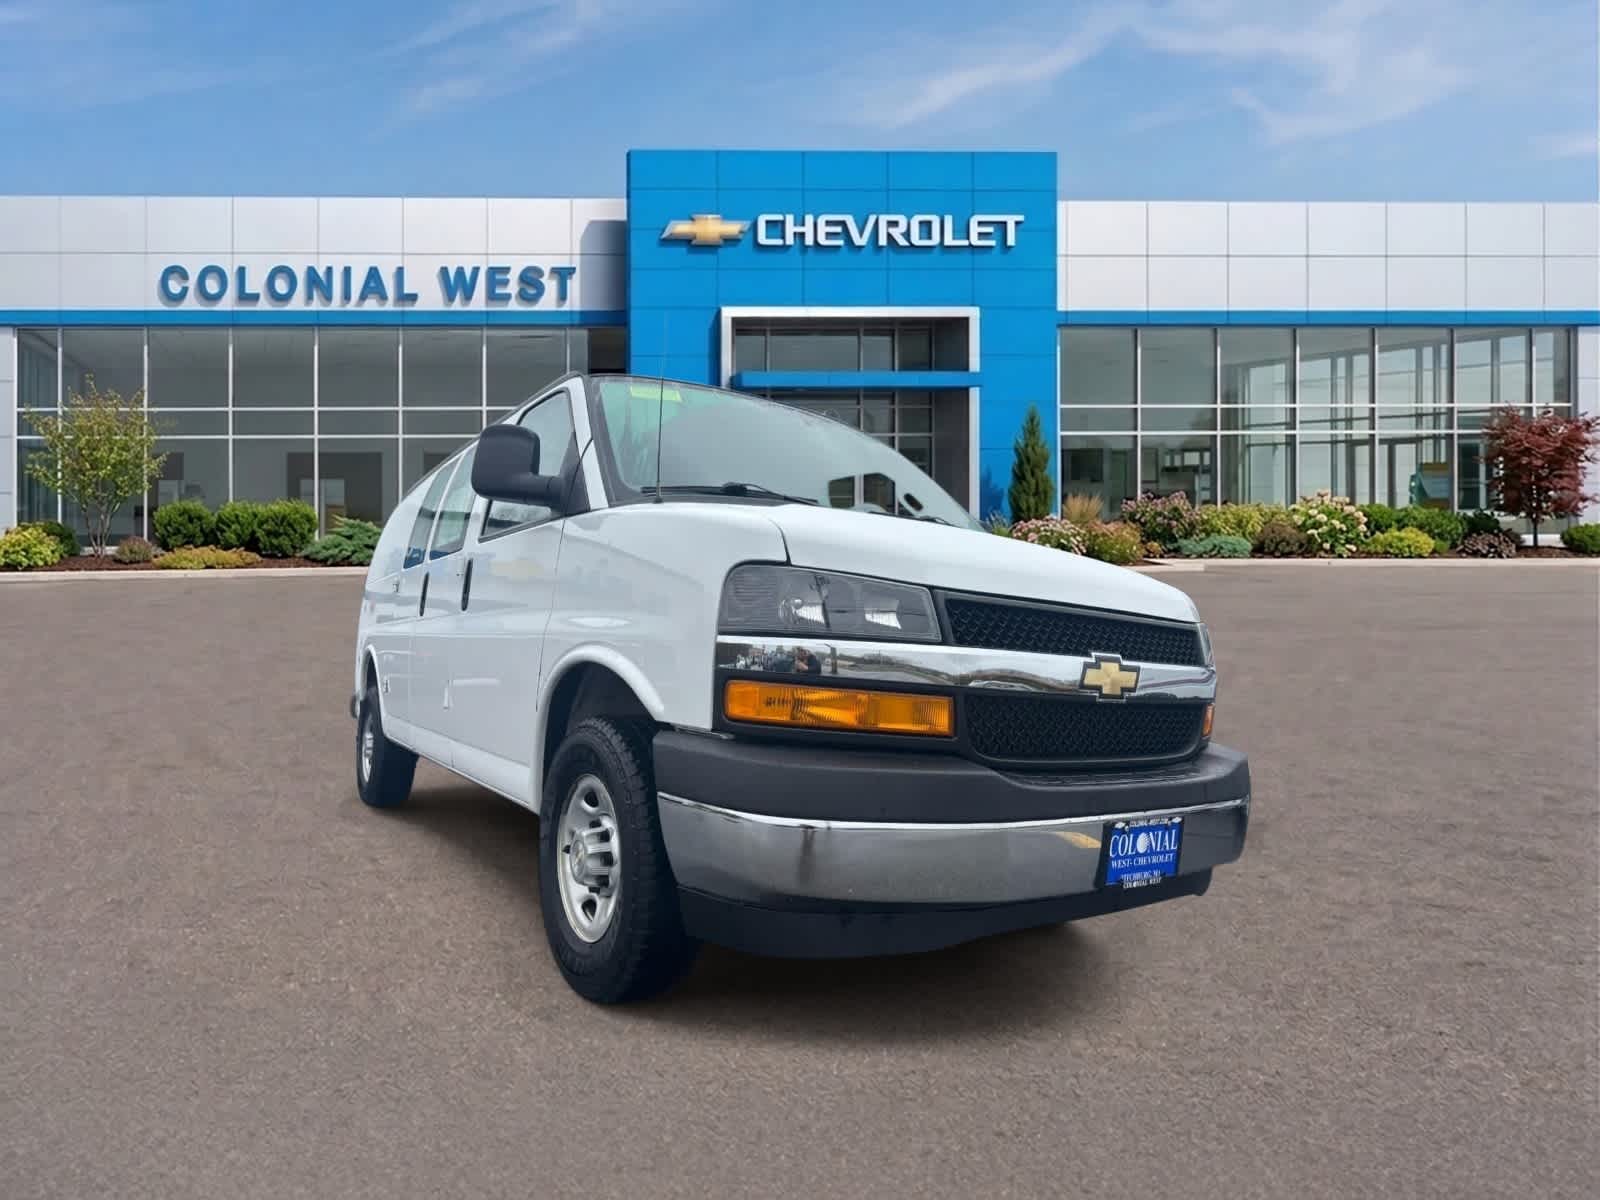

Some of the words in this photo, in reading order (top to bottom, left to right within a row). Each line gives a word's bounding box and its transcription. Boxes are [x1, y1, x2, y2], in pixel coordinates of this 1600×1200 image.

[756, 213, 1025, 247] CHEVROLET
[160, 265, 418, 304] COLONIAL
[438, 265, 577, 303] WEST
[1109, 829, 1178, 857] COLONIAL
[1133, 853, 1174, 866] CHEVROLET
